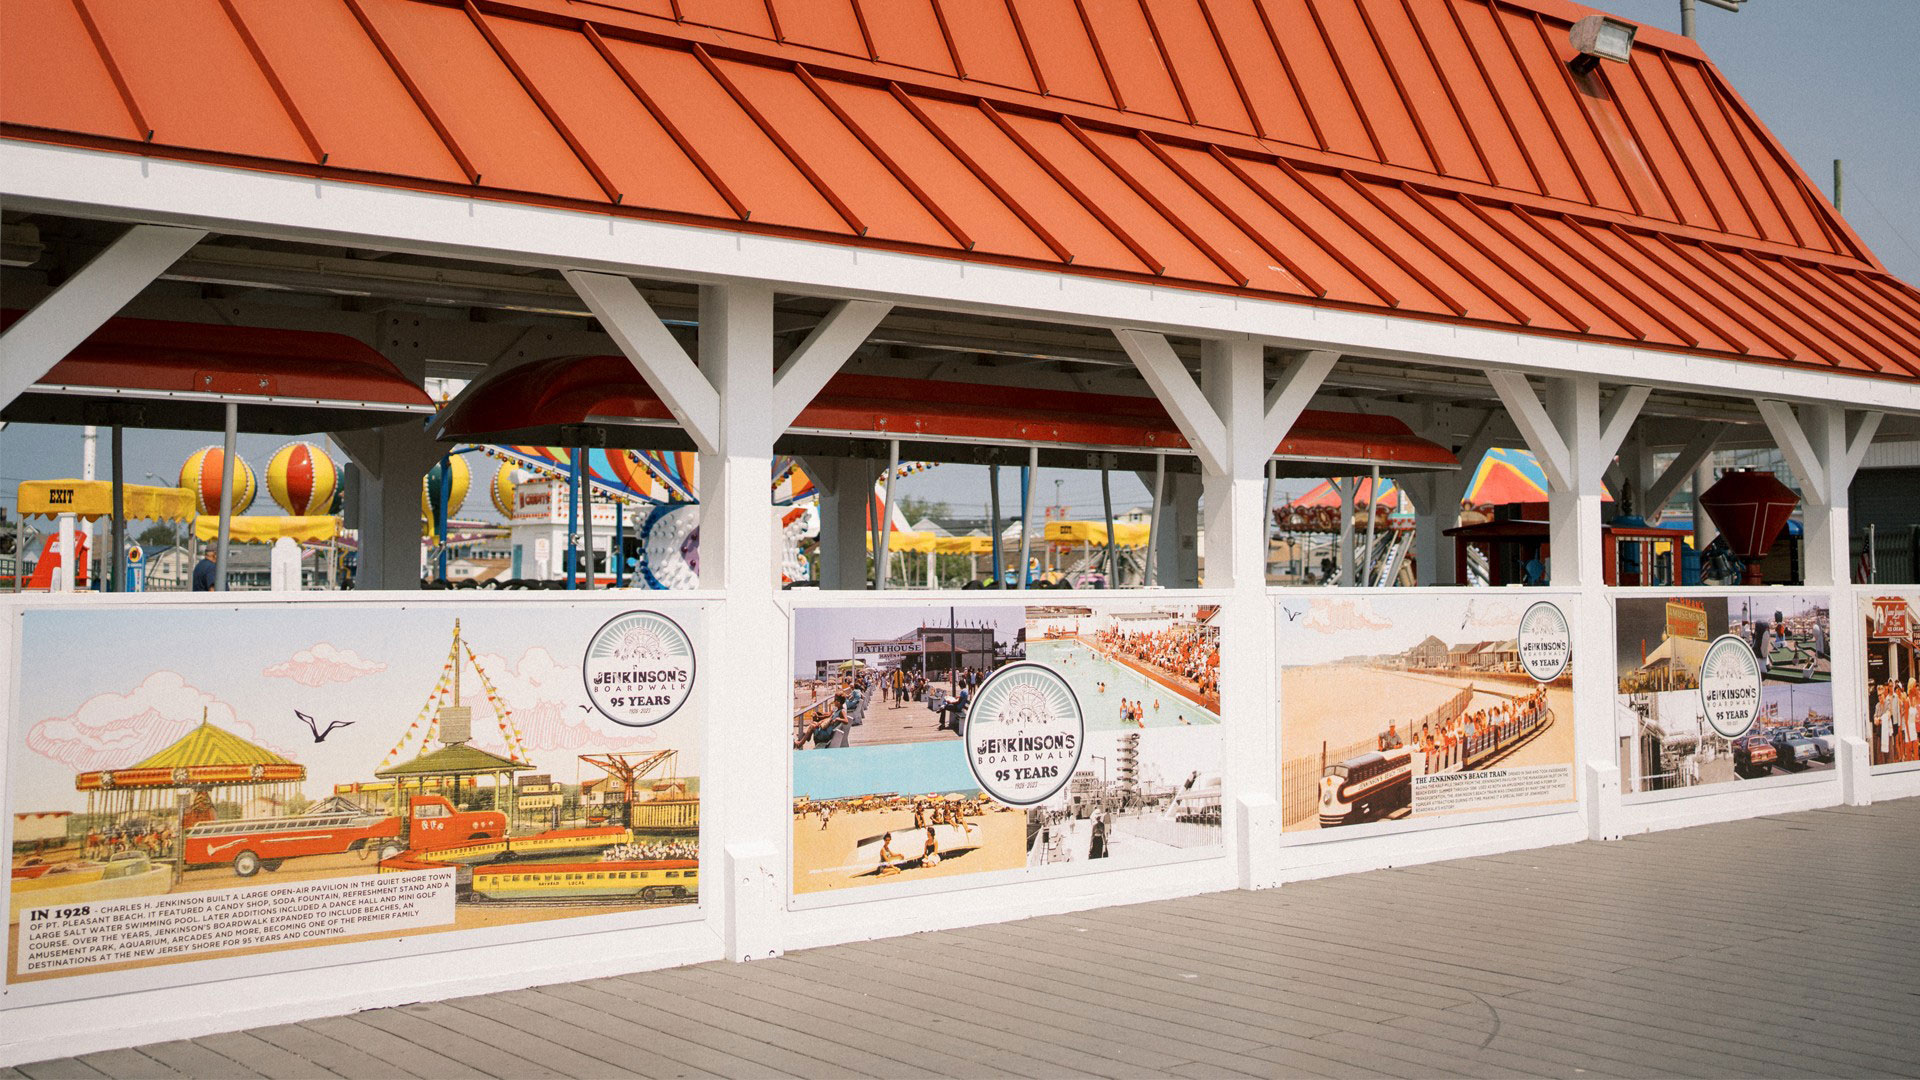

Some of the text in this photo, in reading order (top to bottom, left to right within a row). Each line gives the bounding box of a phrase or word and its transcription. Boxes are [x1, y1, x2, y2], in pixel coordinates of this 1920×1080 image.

[50, 490, 74, 504] EXIT
[1523, 640, 1566, 651] JENKINSON'S
[593, 666, 688, 684] JENKINSON'S
[594, 684, 686, 692] BOARDWALK
[1707, 685, 1757, 701] JENKINSON'S
[610, 696, 671, 707] 95 YEARS
[1716, 710, 1748, 720] 95 YEARS
[977, 731, 1075, 754] JENKINSON'S
[978, 751, 1074, 764] BOARDWALK
[995, 765, 1058, 781] 95 YEARS
[1428, 773, 1467, 782] JENKINSON'S
[30, 909, 48, 921] IN
[55, 905, 90, 919] 1928
[100, 903, 141, 914] CHARLES
[155, 896, 204, 908] JENKINSON
[206, 894, 230, 903] BUILT
[241, 890, 267, 899] LARGE
[270, 886, 309, 896] OPEN-AIR
[311, 882, 348, 892] PAVILION
[376, 877, 398, 886] QUIET
[401, 875, 426, 883] SHORE
[428, 872, 451, 880] TOWN
[62, 916, 109, 927] PLEASANT
[112, 912, 145, 922] BEACH.
[158, 906, 204, 917] FEATURED
[214, 902, 243, 911] CANDY
[246, 900, 270, 908] SHOP,
[272, 897, 295, 905] SODA
[297, 892, 340, 902] FOUNTAIN,
[342, 887, 396, 898] REFRESHMENT
[399, 884, 424, 892] STAND
[28, 939, 69, 950] COURSE.
[72, 936, 98, 945] OVER
[101, 934, 117, 942] THE
[121, 930, 151, 939] YEARS,
[154, 924, 210, 936] JENKINSON'S
[213, 917, 267, 929] BOARDWALK
[269, 912, 313, 923] EXPANDED
[328, 907, 361, 917] INCLUDE
[364, 903, 400, 913] BEACHES,
[29, 930, 60, 940] LARGE
[63, 928, 86, 936] SALT
[89, 924, 122, 933] WATER
[124, 918, 171, 930] SWIMMING
[174, 916, 200, 924] POOL.
[202, 912, 229, 921] LATER
[232, 908, 276, 918] ADDITIONS
[279, 903, 319, 913] INCLUDED
[329, 899, 355, 908] DANCE
[28, 946, 86, 959] AMUSEMENT
[89, 943, 116, 952] PARK,
[119, 937, 169, 949] AQUARIUM,
[172, 933, 212, 943] ARCADES
[215, 930, 233, 938] AND
[235, 927, 261, 936] MORE,
[263, 922, 306, 933] BECOMING
[357, 913, 389, 922] PREMIER
[391, 910, 419, 918] FAMILY
[27, 955, 96, 969] DESTINATIONS
[114, 951, 130, 959] THE
[133, 948, 154, 957] NEW
[158, 944, 188, 954] JERSEY
[191, 941, 219, 950] SHORE
[222, 939, 239, 947] FOR
[254, 934, 280, 943] YEARS
[283, 932, 300, 940] AND
[302, 926, 346, 938] COUNTING.
